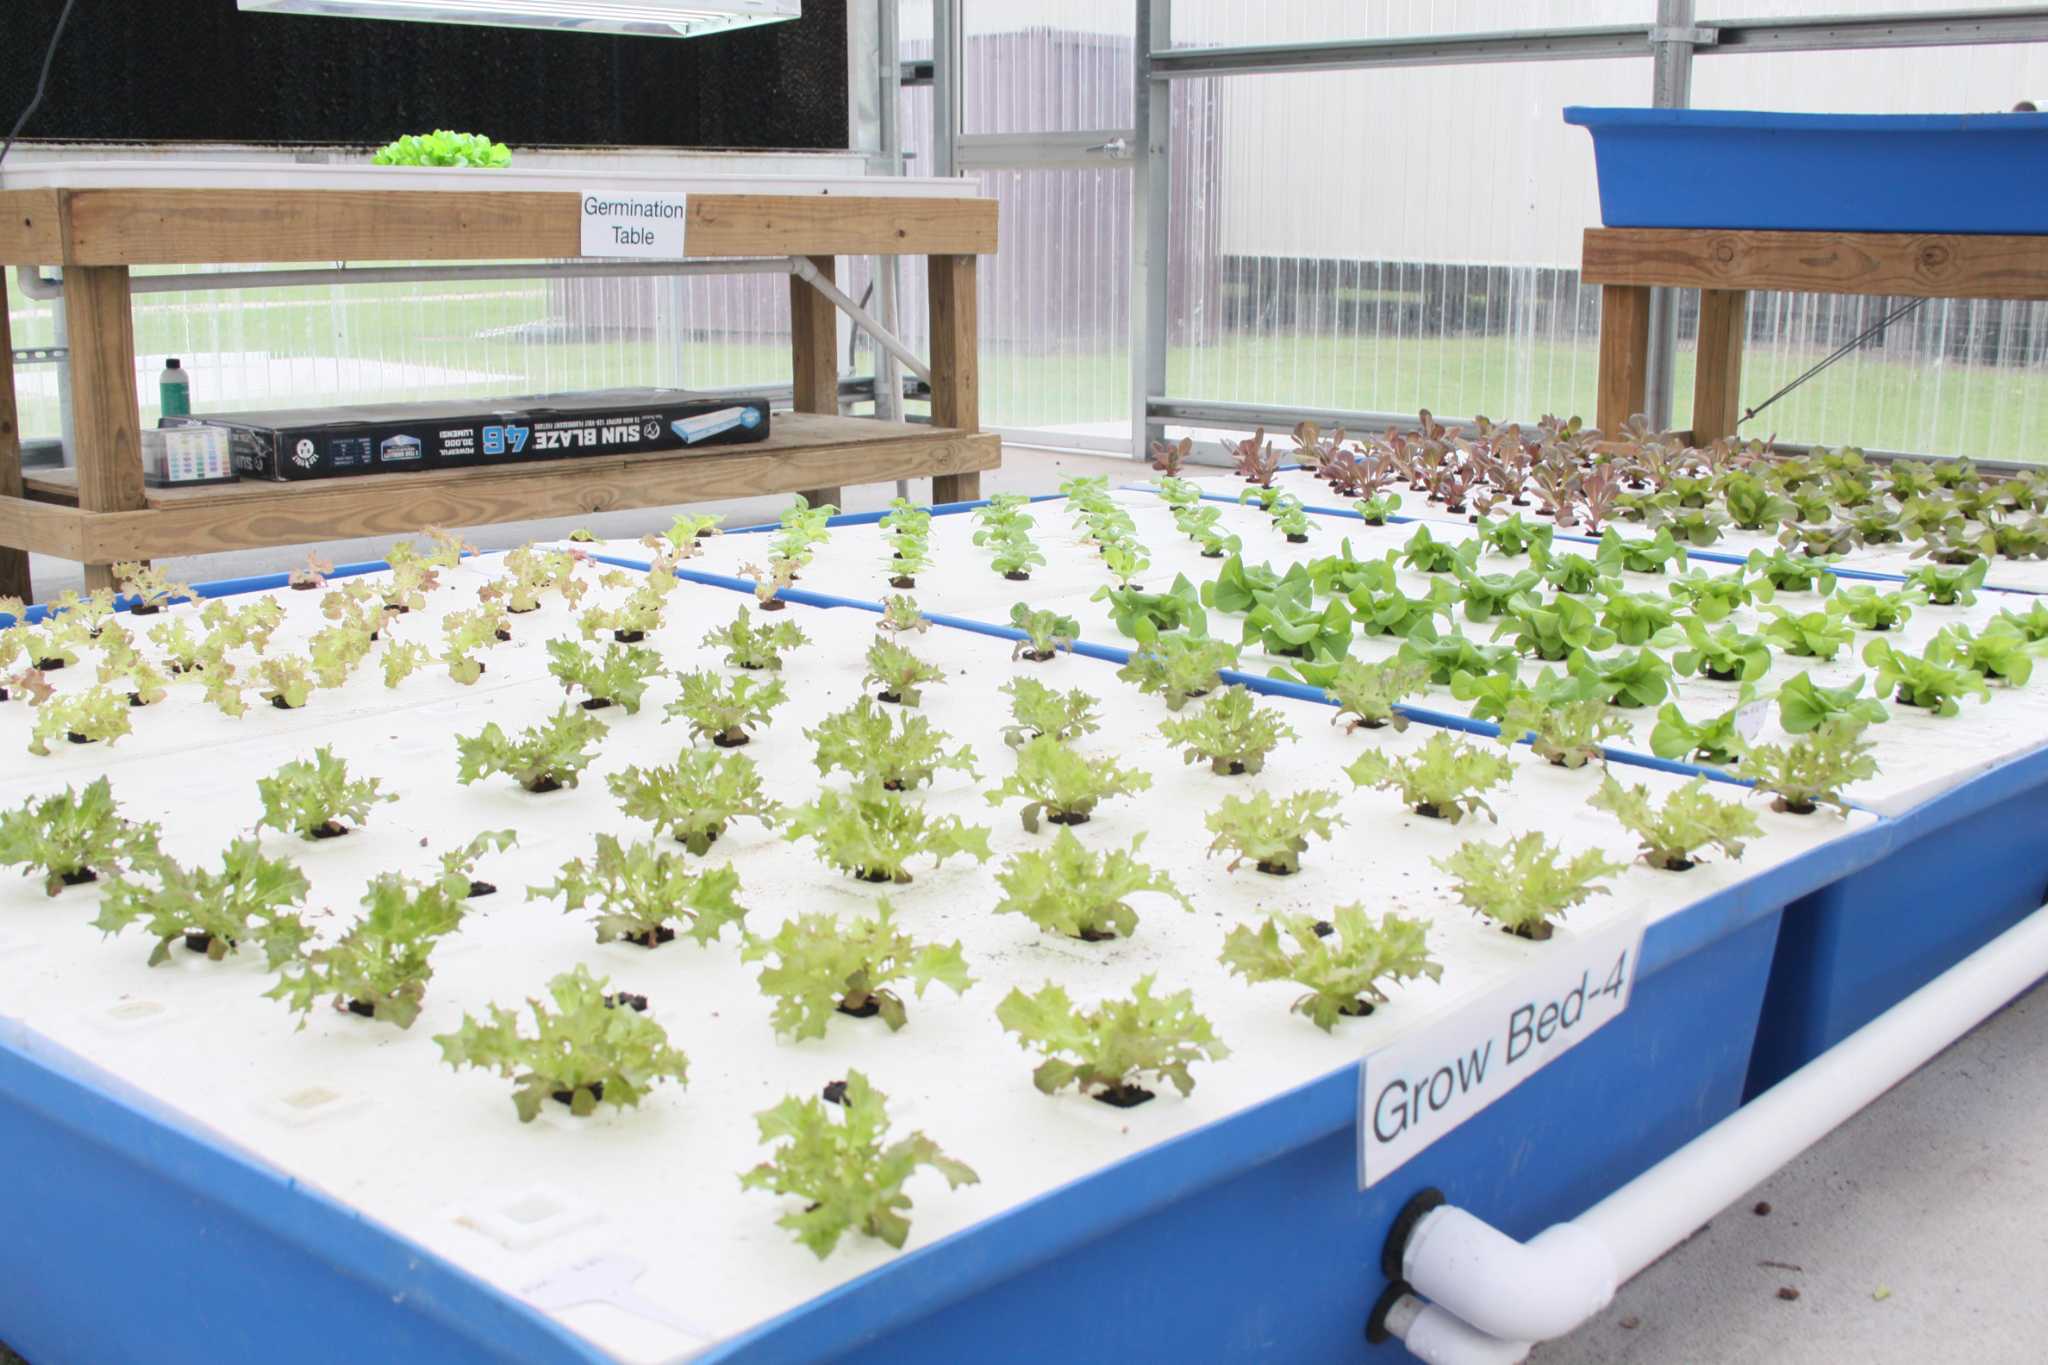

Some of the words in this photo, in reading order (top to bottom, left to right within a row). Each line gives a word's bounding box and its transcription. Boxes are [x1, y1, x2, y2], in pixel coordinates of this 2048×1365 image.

[584, 196, 684, 219] Germination
[612, 226, 655, 245] Table
[482, 425, 530, 455] 46
[534, 428, 597, 450] BLAZE
[601, 425, 640, 444] SUN
[1373, 1039, 1492, 1143] Grow
[1506, 949, 1627, 1065] Bed-4
